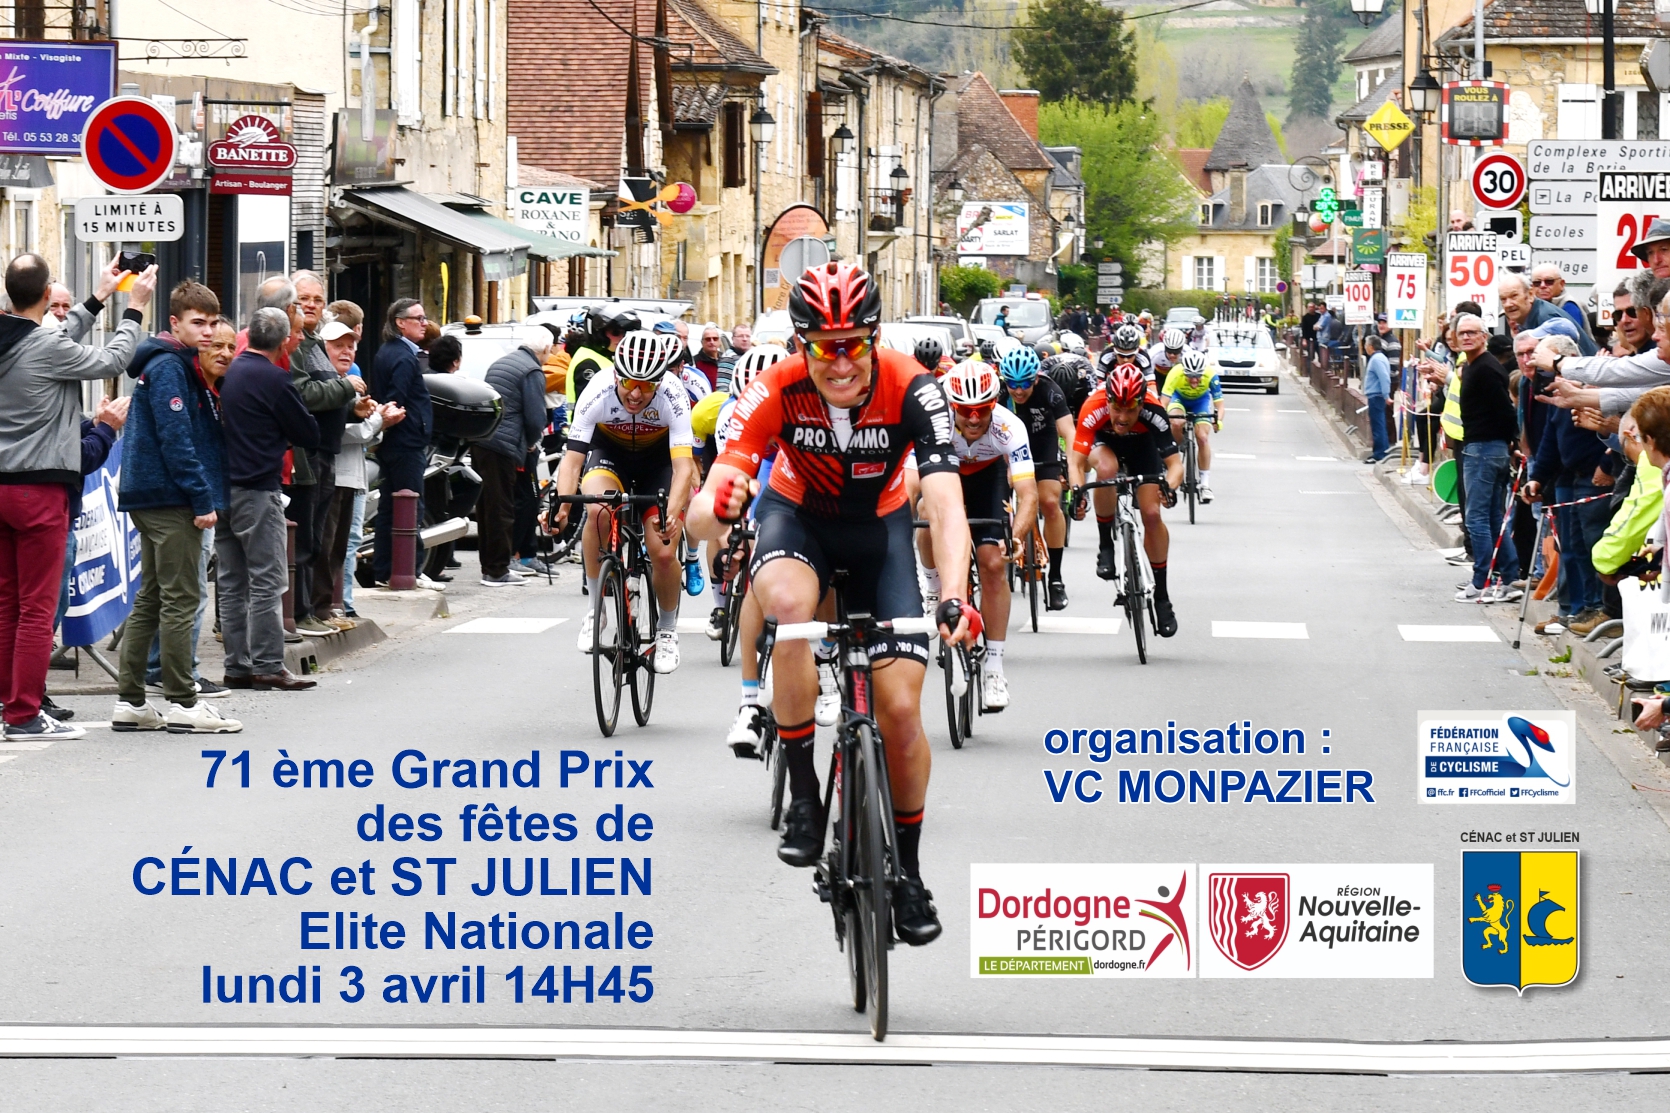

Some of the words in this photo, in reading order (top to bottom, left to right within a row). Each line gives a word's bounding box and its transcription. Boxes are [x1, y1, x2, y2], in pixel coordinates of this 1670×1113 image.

[5, 53, 30, 61] Mixte
[40, 54, 82, 63] Visagiste
[21, 88, 95, 120] Coiffure
[1369, 122, 1410, 131] PRESSE
[3, 132, 20, 142] Tél.
[23, 132, 37, 142] 05
[39, 132, 53, 142] 53
[55, 133, 69, 143] 28
[216, 147, 289, 163] BANETTE
[1533, 145, 1607, 160] Complexe
[1618, 145, 1670, 161] Sporti
[1533, 162, 1550, 173] de
[1561, 162, 1575, 173] la
[215, 180, 243, 188] Artisan
[248, 181, 288, 191] Boulanger
[1483, 170, 1515, 194] 30
[520, 191, 583, 206] CAVE
[1556, 191, 1572, 203] La
[95, 201, 148, 216] LIMITÉ
[154, 201, 163, 216] À
[521, 209, 582, 221] ROXANE
[82, 221, 100, 234] 15
[106, 220, 176, 233] MINUTES
[546, 221, 556, 229] &
[1535, 225, 1585, 238] Ecoles
[1450, 234, 1497, 252] ARRIVÉE
[1450, 255, 1495, 287] 50
[1345, 284, 1371, 302] 100
[1396, 274, 1416, 300] 75
[1471, 293, 1486, 304] m
[735, 381, 770, 421] IMMO
[913, 382, 946, 412] PRO
[793, 427, 827, 448] PRO
